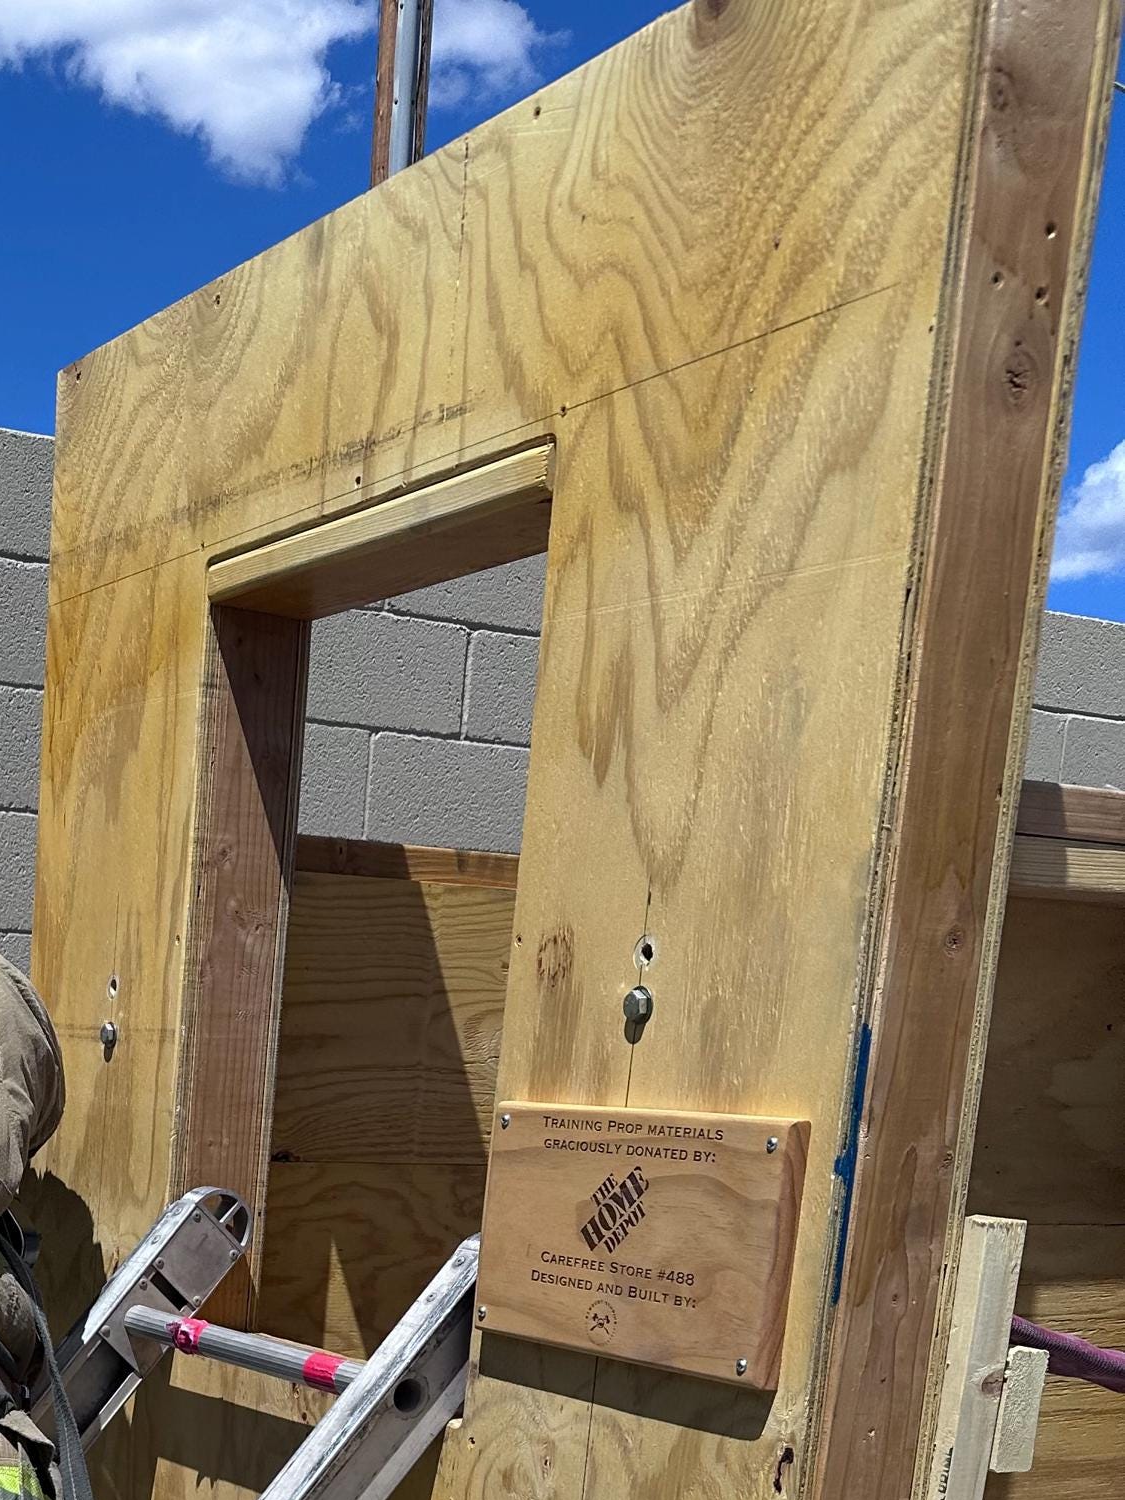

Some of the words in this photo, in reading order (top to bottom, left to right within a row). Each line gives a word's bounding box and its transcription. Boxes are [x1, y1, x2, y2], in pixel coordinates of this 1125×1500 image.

[543, 1115, 602, 1131] TRAINING
[607, 1120, 643, 1134] PROP
[647, 1124, 724, 1140] MATERIALS
[544, 1138, 622, 1154] GRACIOUSLY
[626, 1145, 688, 1161] DONATED
[693, 1150, 716, 1163] BY:
[590, 1173, 618, 1207] THE
[580, 1166, 649, 1251] HOME
[603, 1200, 646, 1254] DEPOT
[540, 1251, 605, 1272] CAREFREE
[609, 1261, 652, 1279] STORE
[657, 1269, 695, 1286] #488
[531, 1269, 593, 1290] DESIGNED
[596, 1282, 623, 1296] AND
[628, 1285, 669, 1304] BUILT
[673, 1295, 696, 1308] BY:
